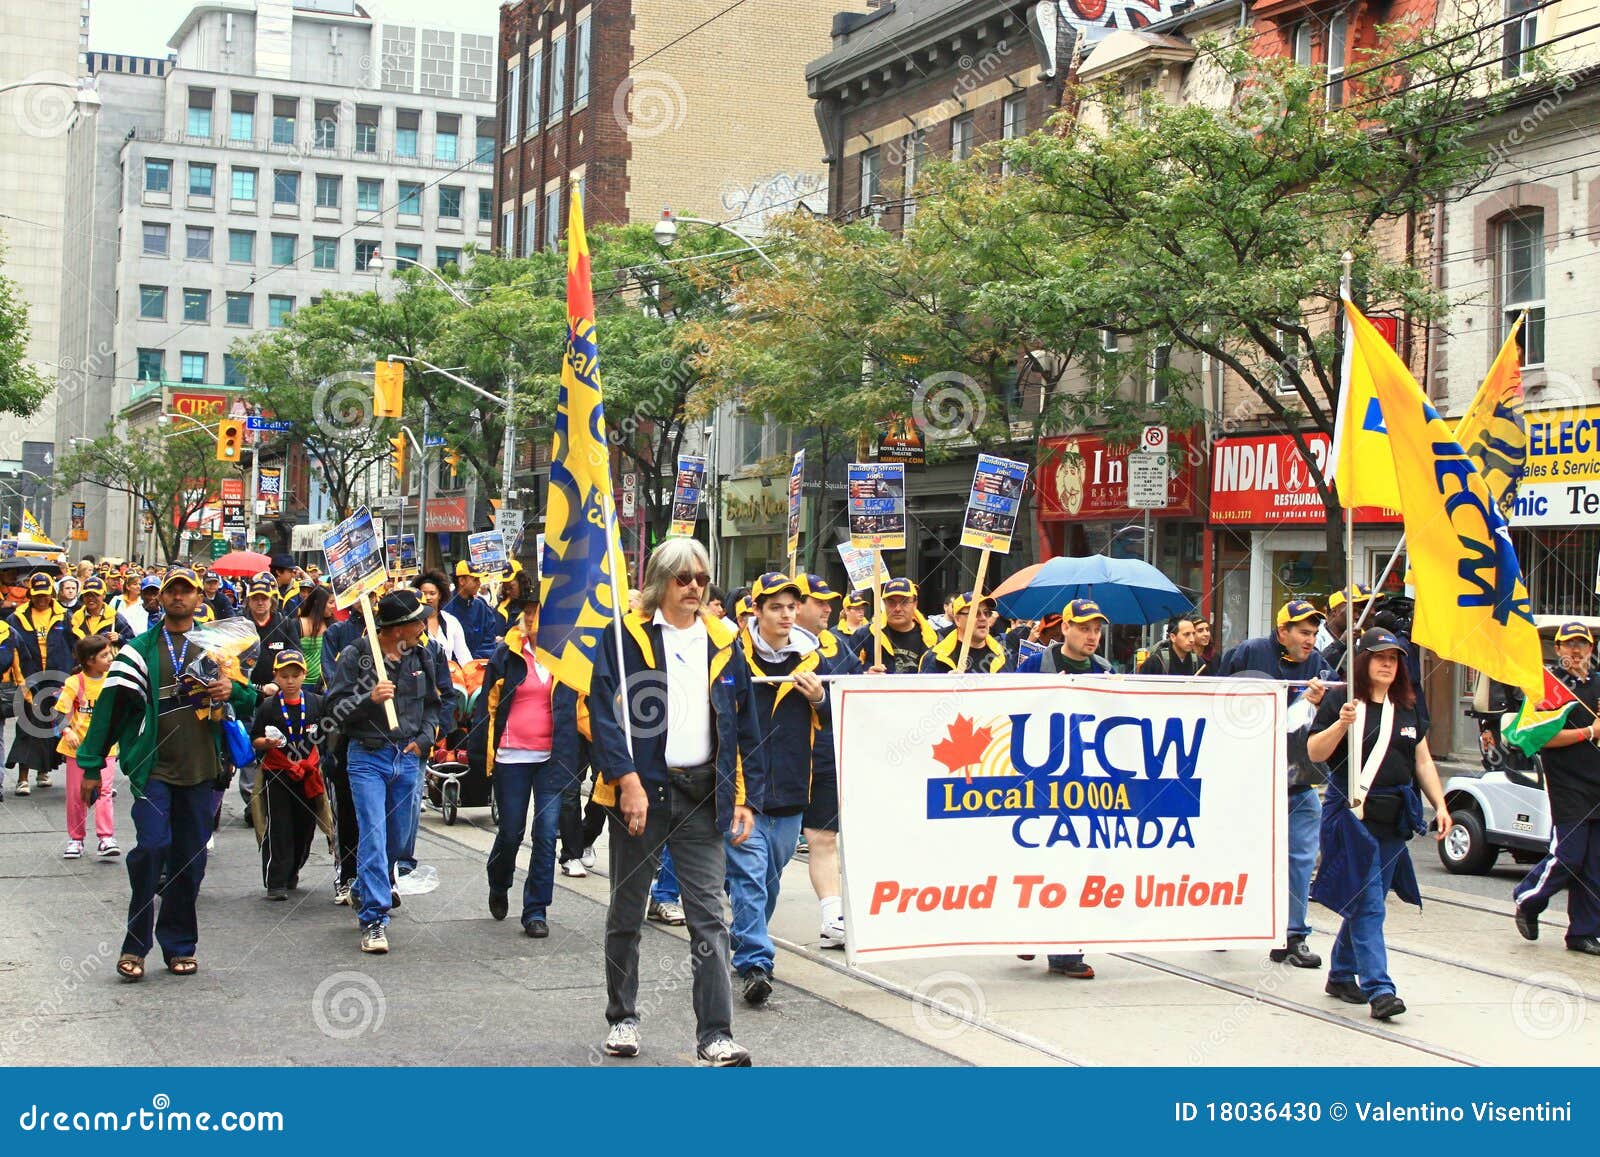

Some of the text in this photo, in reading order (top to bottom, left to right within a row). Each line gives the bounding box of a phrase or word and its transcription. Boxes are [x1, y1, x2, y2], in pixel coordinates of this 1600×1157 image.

[176, 398, 223, 416] CIBC
[879, 464, 903, 473] Strong
[1214, 443, 1279, 492] INDIA
[1524, 463, 1547, 477] ales
[1551, 460, 1559, 476] &
[1274, 493, 1324, 506] RESTAURAN
[1008, 711, 1207, 780] UFCW
[943, 781, 1132, 812] Local 1000A
[1012, 816, 1196, 849] CANADA
[869, 873, 1249, 915] Proud To Be Union!
